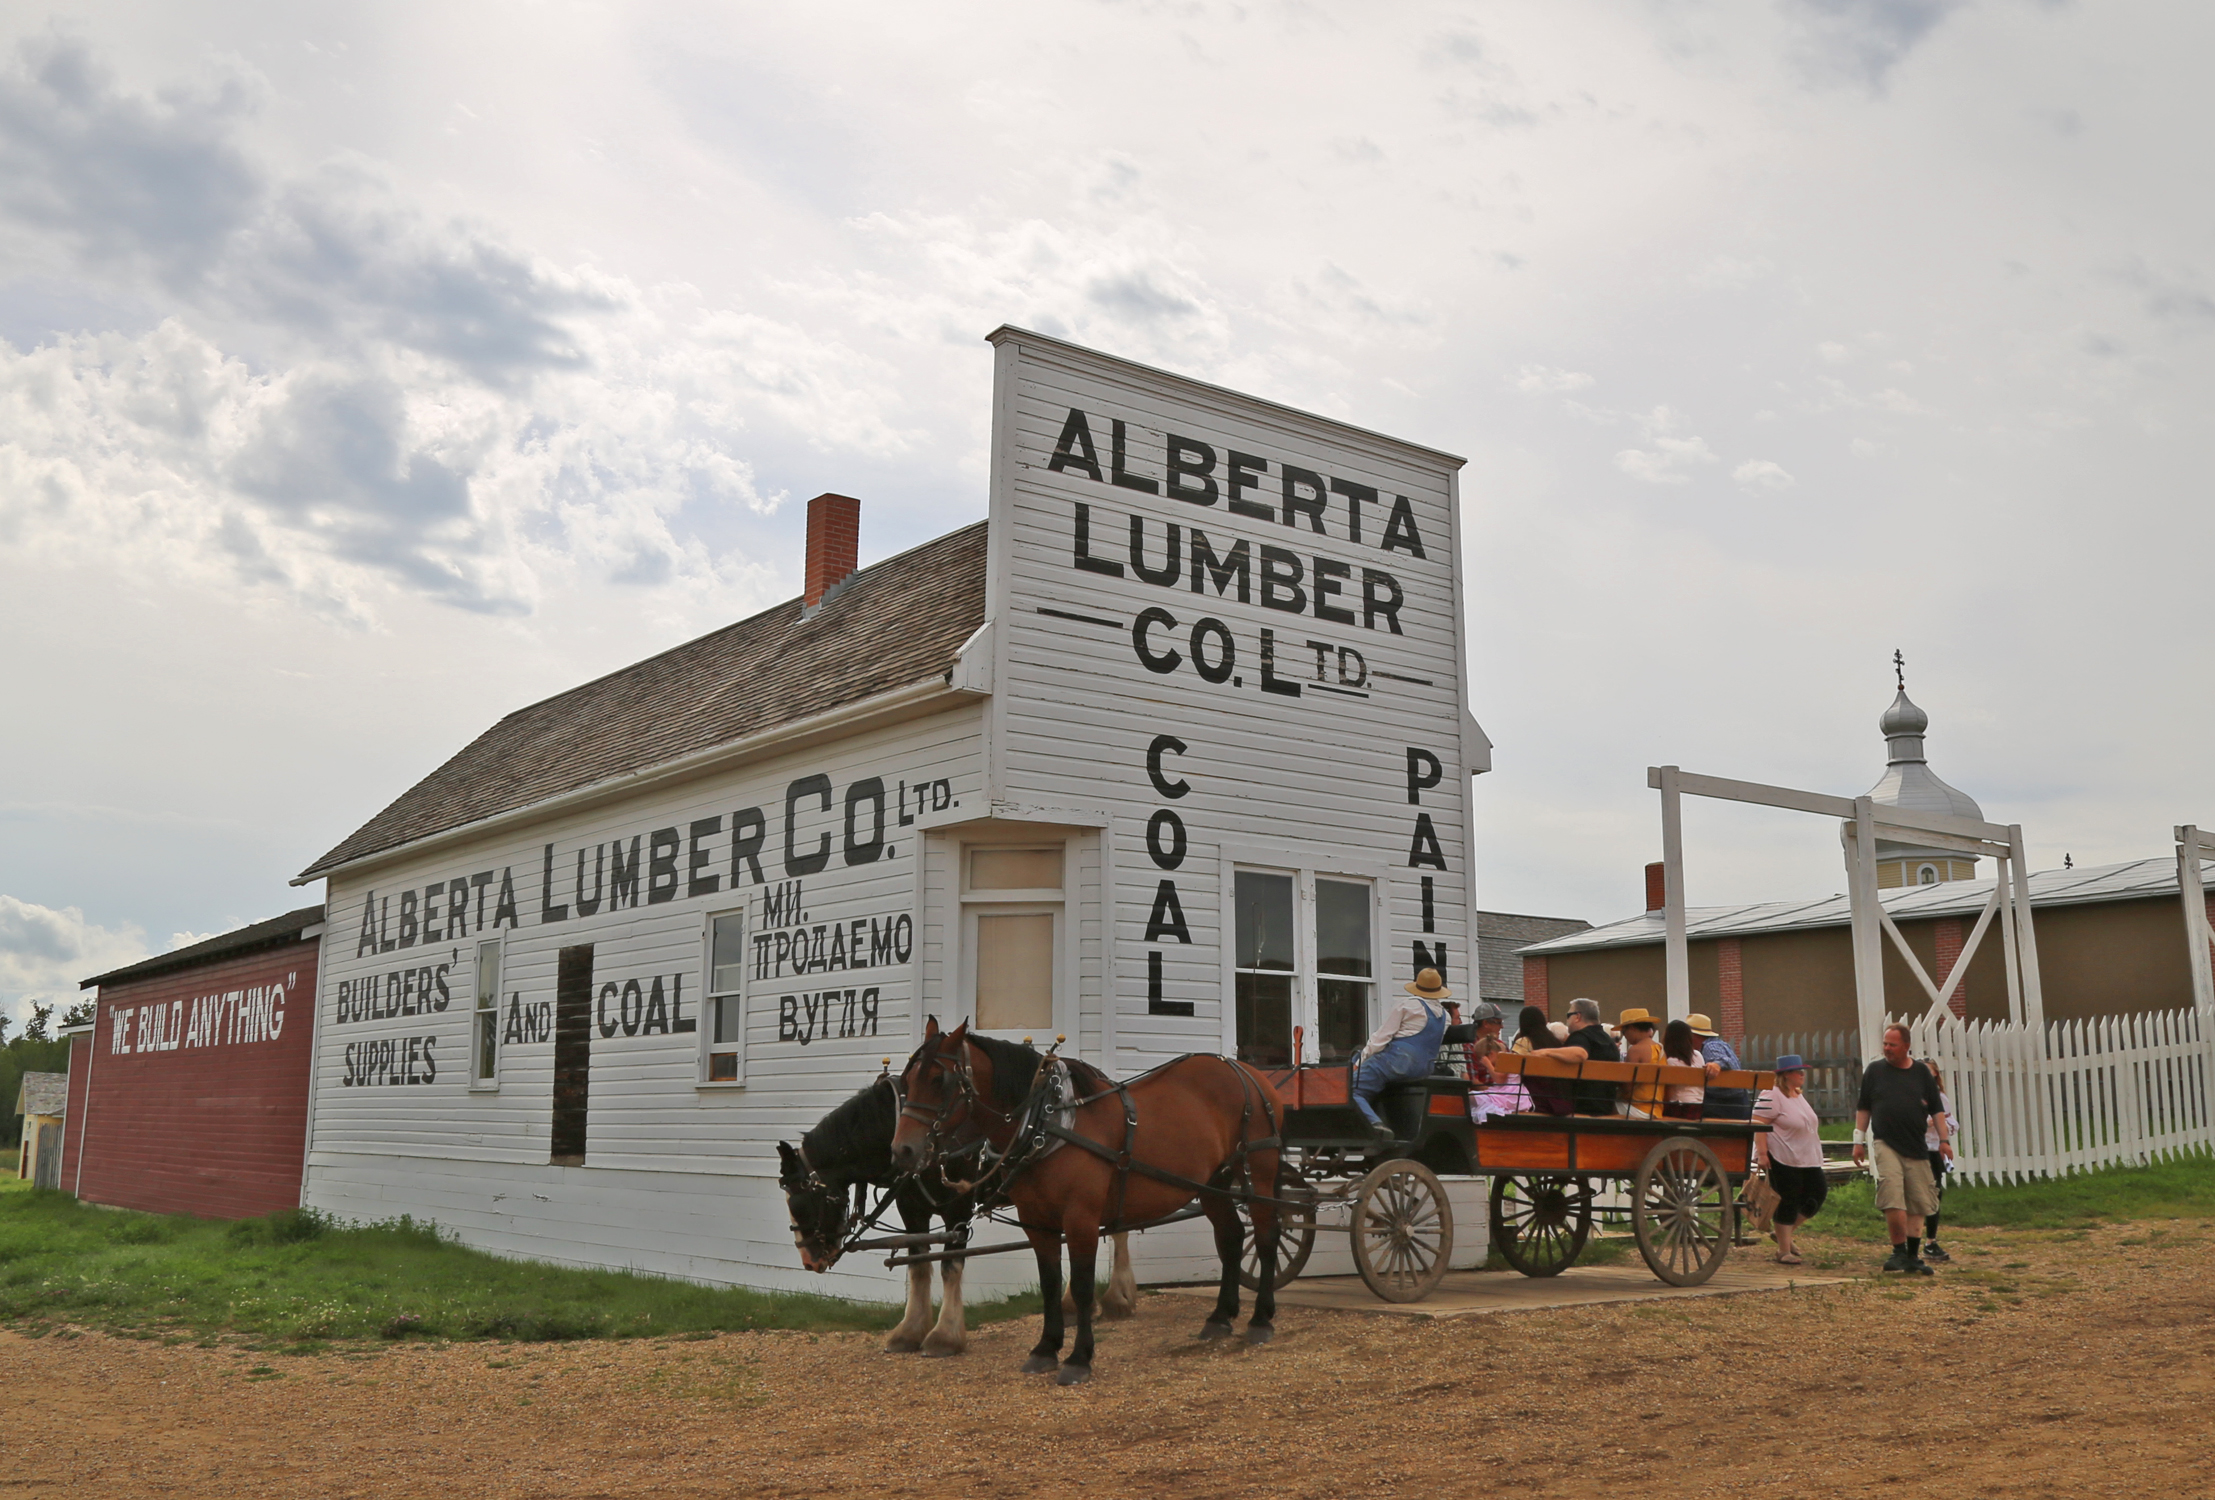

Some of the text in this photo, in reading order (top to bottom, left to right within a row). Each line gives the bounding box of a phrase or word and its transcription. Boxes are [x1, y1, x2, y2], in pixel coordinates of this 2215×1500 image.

[1047, 407, 1427, 560] ALBERTA
[1072, 501, 1404, 636] LUMBER
[1131, 606, 1374, 699] CO. LTD.
[357, 773, 960, 958] ALBERTA LUMBER CO. LTD.
[763, 879, 809, 930] МИ.
[1144, 734, 1194, 1017] COAL
[753, 913, 913, 980] ПРОДАЕМО
[136, 1000, 183, 1053] BUILD
[504, 973, 696, 1044] AND COAL
[343, 1036, 437, 1086] SUPPLIES
